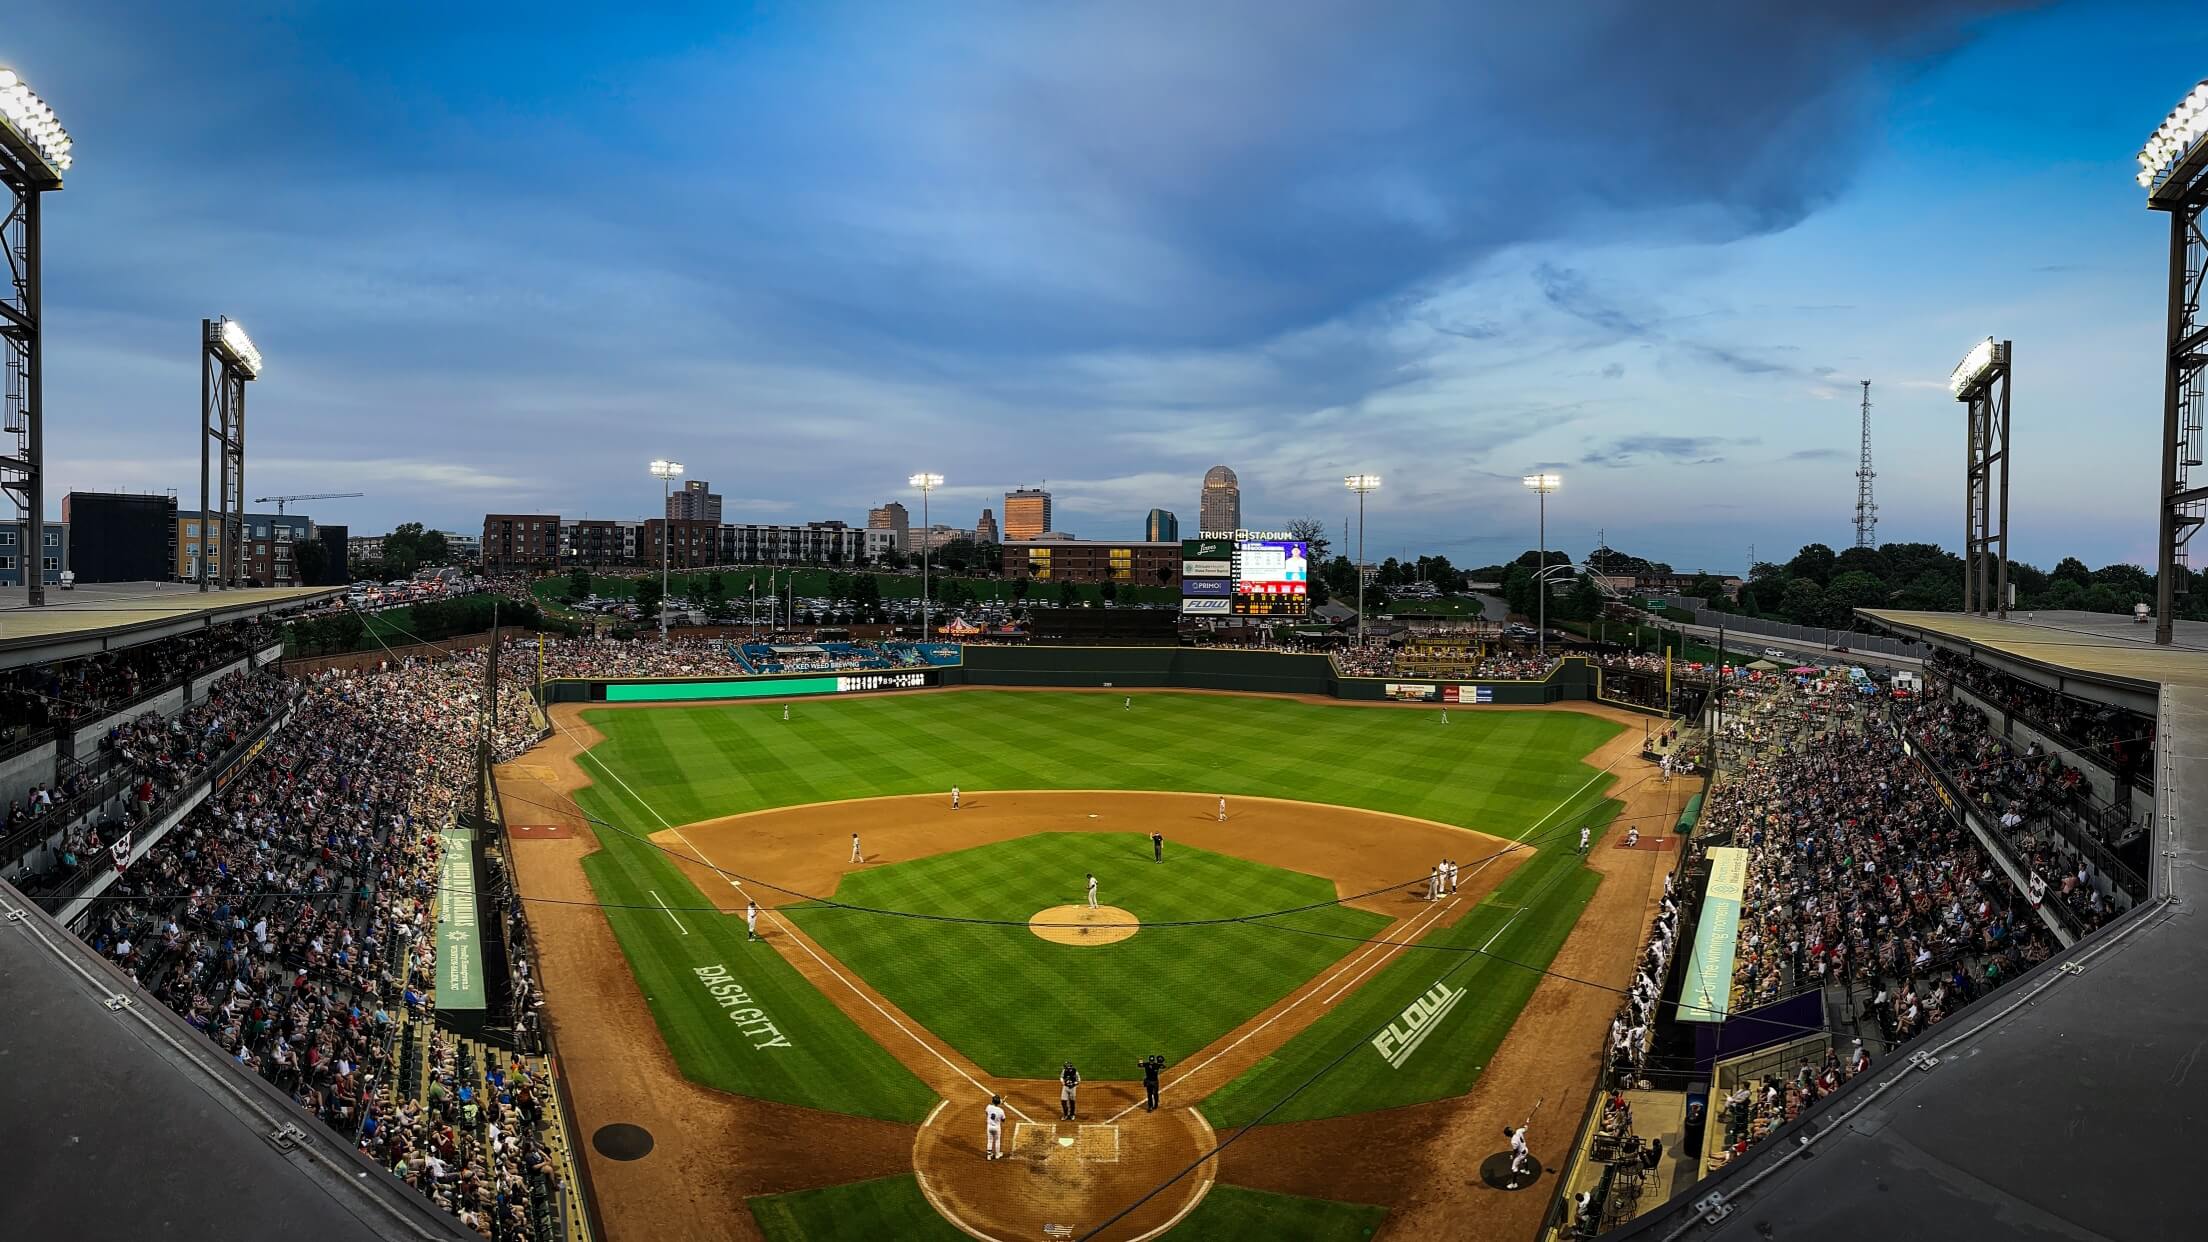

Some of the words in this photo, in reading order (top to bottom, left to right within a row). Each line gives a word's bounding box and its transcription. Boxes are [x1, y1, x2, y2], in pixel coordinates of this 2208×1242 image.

[1199, 531, 1234, 540] TRUIST
[1249, 531, 1293, 540] STADIUM
[1187, 600, 1229, 608] FLOW
[783, 663, 810, 671] WICKED
[1712, 902, 1729, 933] moments
[1706, 933, 1729, 962] winning
[1698, 964, 1719, 979] the
[1695, 981, 1716, 993] for
[692, 964, 754, 1008] DASH
[729, 1008, 792, 1051] CITY
[1371, 981, 1453, 1060] FLOW
